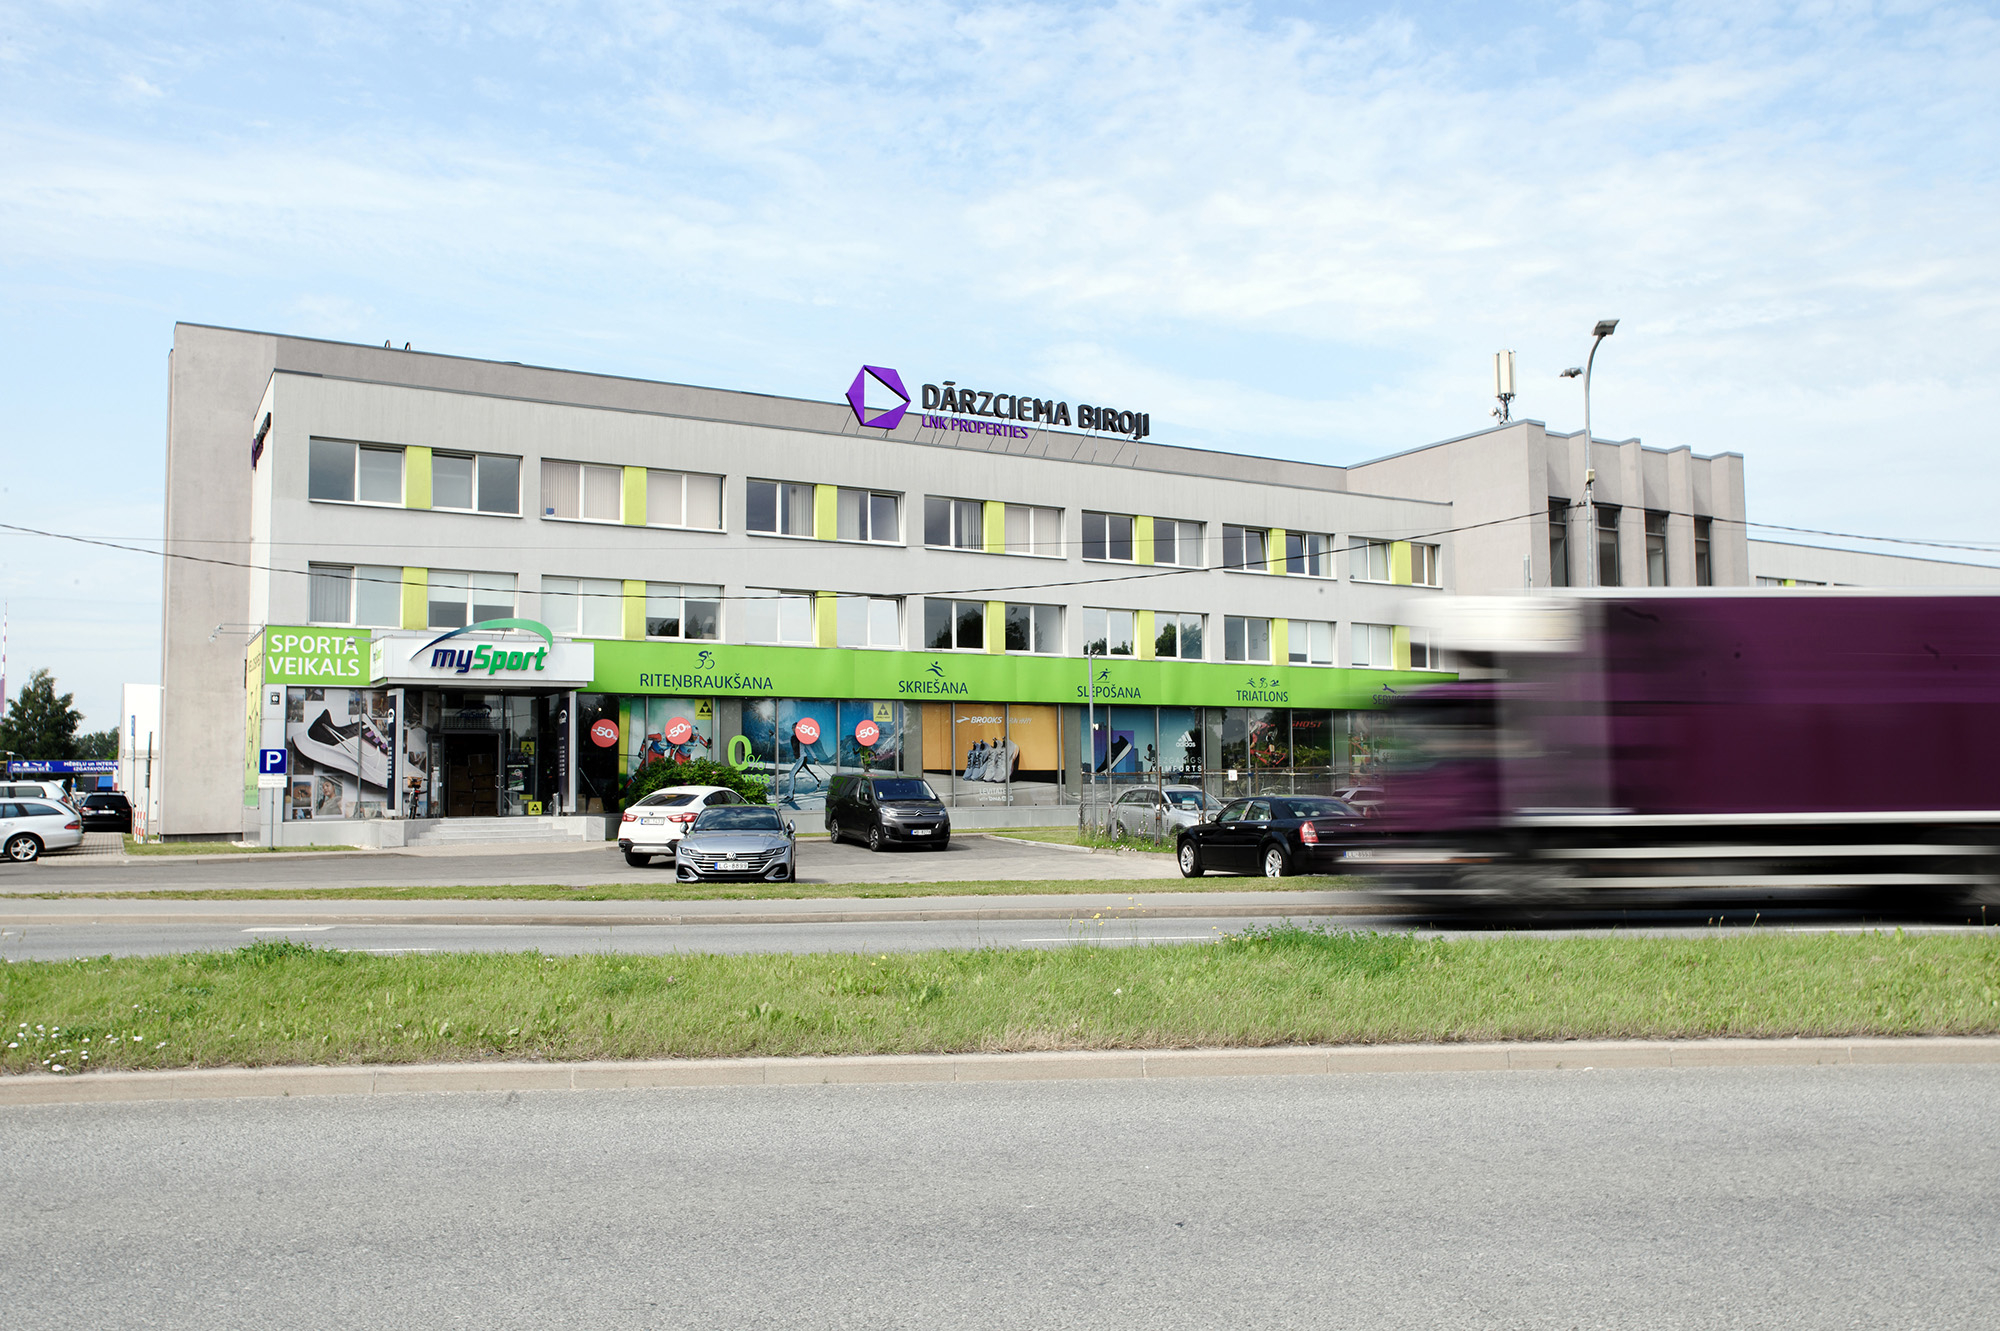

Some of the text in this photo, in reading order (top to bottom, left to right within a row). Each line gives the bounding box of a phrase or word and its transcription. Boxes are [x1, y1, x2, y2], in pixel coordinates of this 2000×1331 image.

[921, 381, 1150, 440] DĀRZCIEMA BIROJI
[921, 414, 1029, 439] LNK PROPERTIES
[271, 635, 359, 655] SPORTA
[268, 656, 360, 676] VEIKALS
[431, 644, 548, 675] mySport
[640, 673, 773, 691] RITEŅBRAUKŠANA
[898, 679, 968, 694] SKRIEŠANA
[1236, 690, 1288, 702] TRIATLONS
[970, 716, 1003, 724] BROOKS
[266, 751, 282, 771] P
